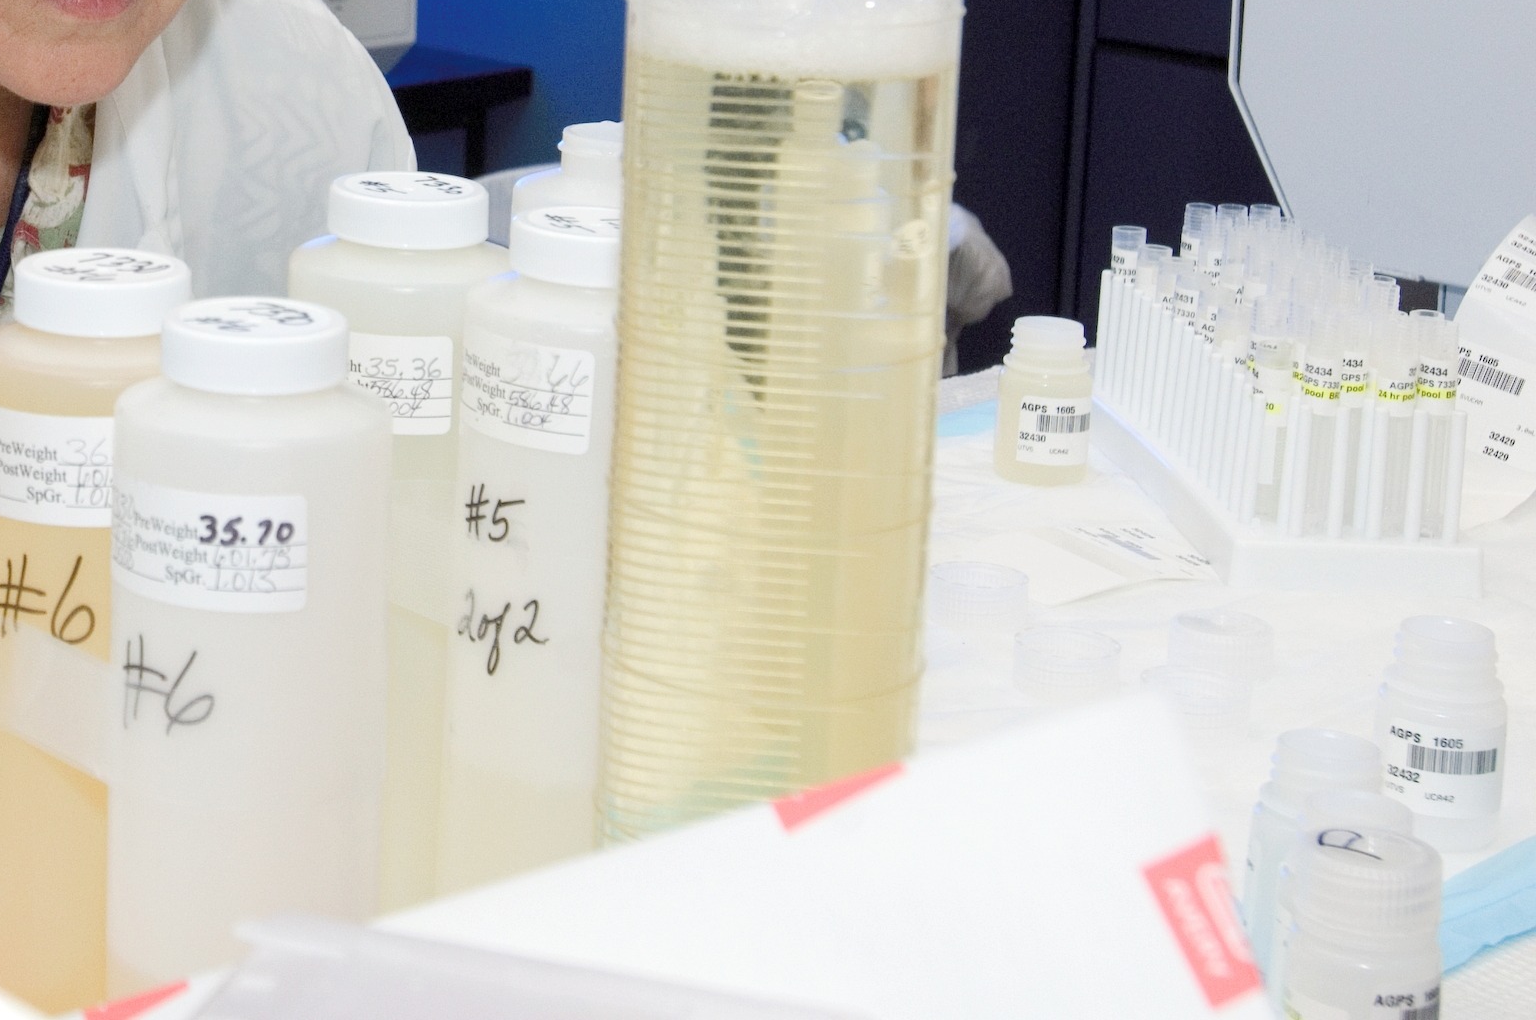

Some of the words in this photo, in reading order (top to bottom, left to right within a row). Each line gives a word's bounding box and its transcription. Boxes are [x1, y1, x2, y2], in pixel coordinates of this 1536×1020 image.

[1020, 401, 1048, 414] AGPS
[1056, 405, 1076, 415] 1605
[1019, 431, 1047, 443] 32430
[1488, 430, 1517, 448] 32429
[1482, 445, 1511, 462] 32429
[465, 482, 527, 542] #5
[198, 513, 296, 547] 35.70
[512, 598, 550, 646] 2
[122, 632, 215, 737] #6
[1389, 724, 1423, 744] AGPS
[1432, 737, 1465, 749] 1605
[1386, 763, 1422, 784] 32432
[1373, 993, 1415, 1008] AGPS
